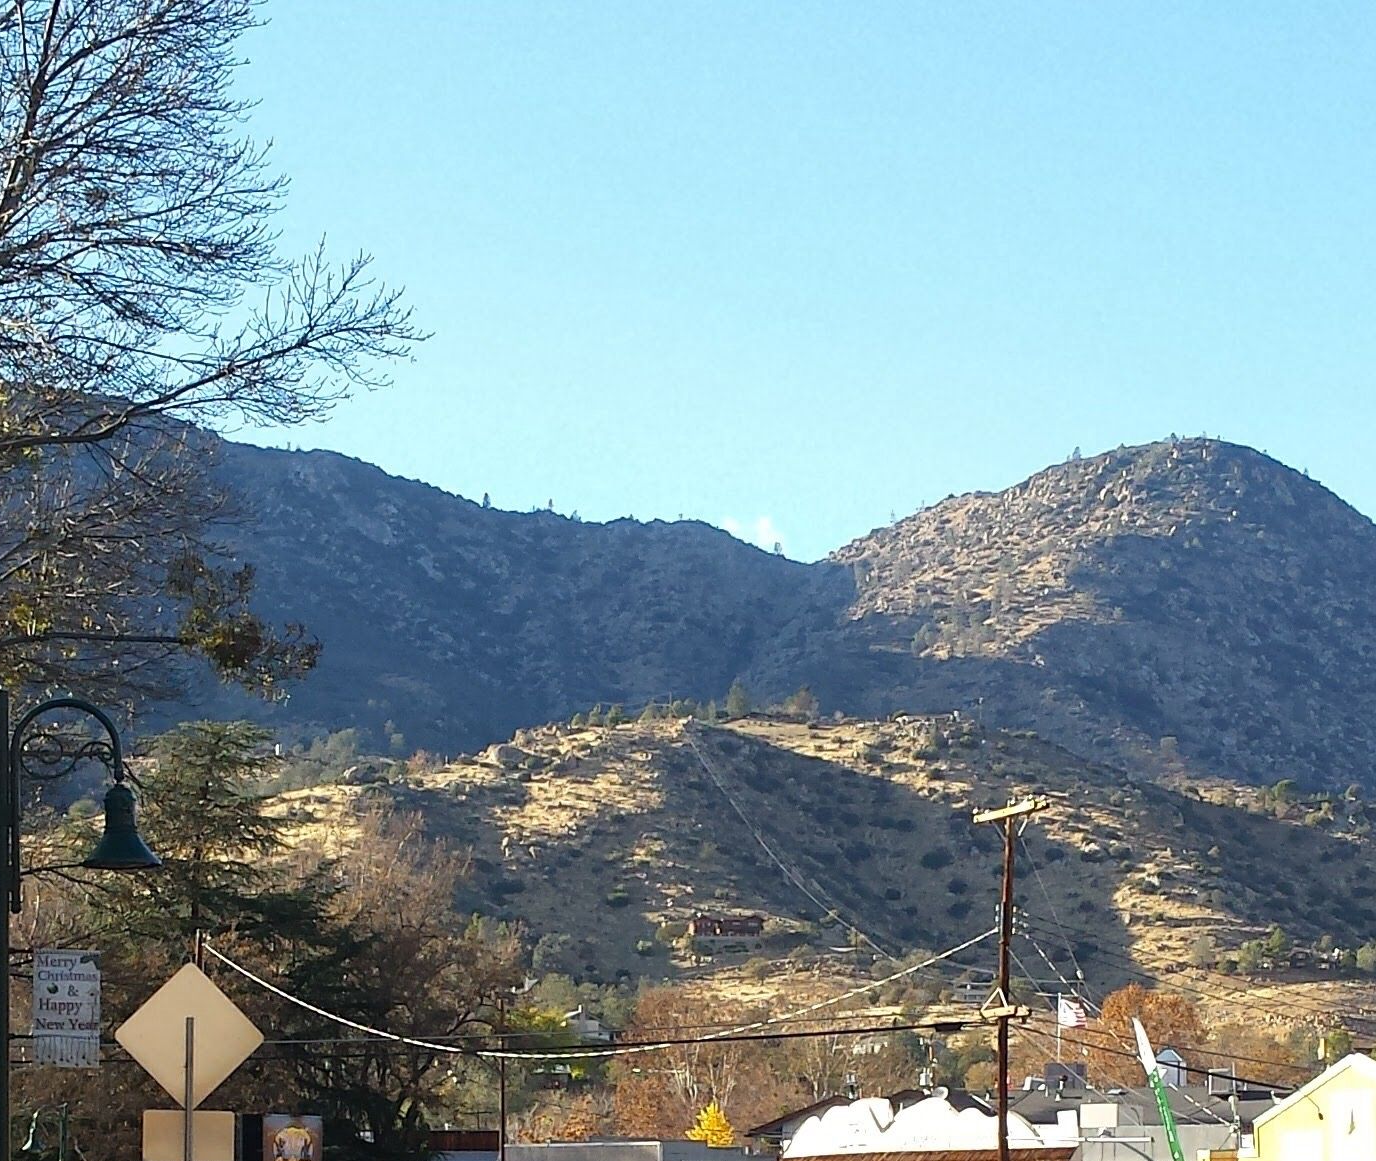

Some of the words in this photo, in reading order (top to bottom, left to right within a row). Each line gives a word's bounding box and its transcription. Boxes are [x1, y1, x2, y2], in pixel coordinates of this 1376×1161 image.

[37, 955, 77, 971] Merry
[38, 970, 98, 982] Christmas
[67, 984, 79, 997] &
[39, 998, 82, 1016] Happy
[36, 1018, 65, 1031] New
[69, 1018, 99, 1031] Year
